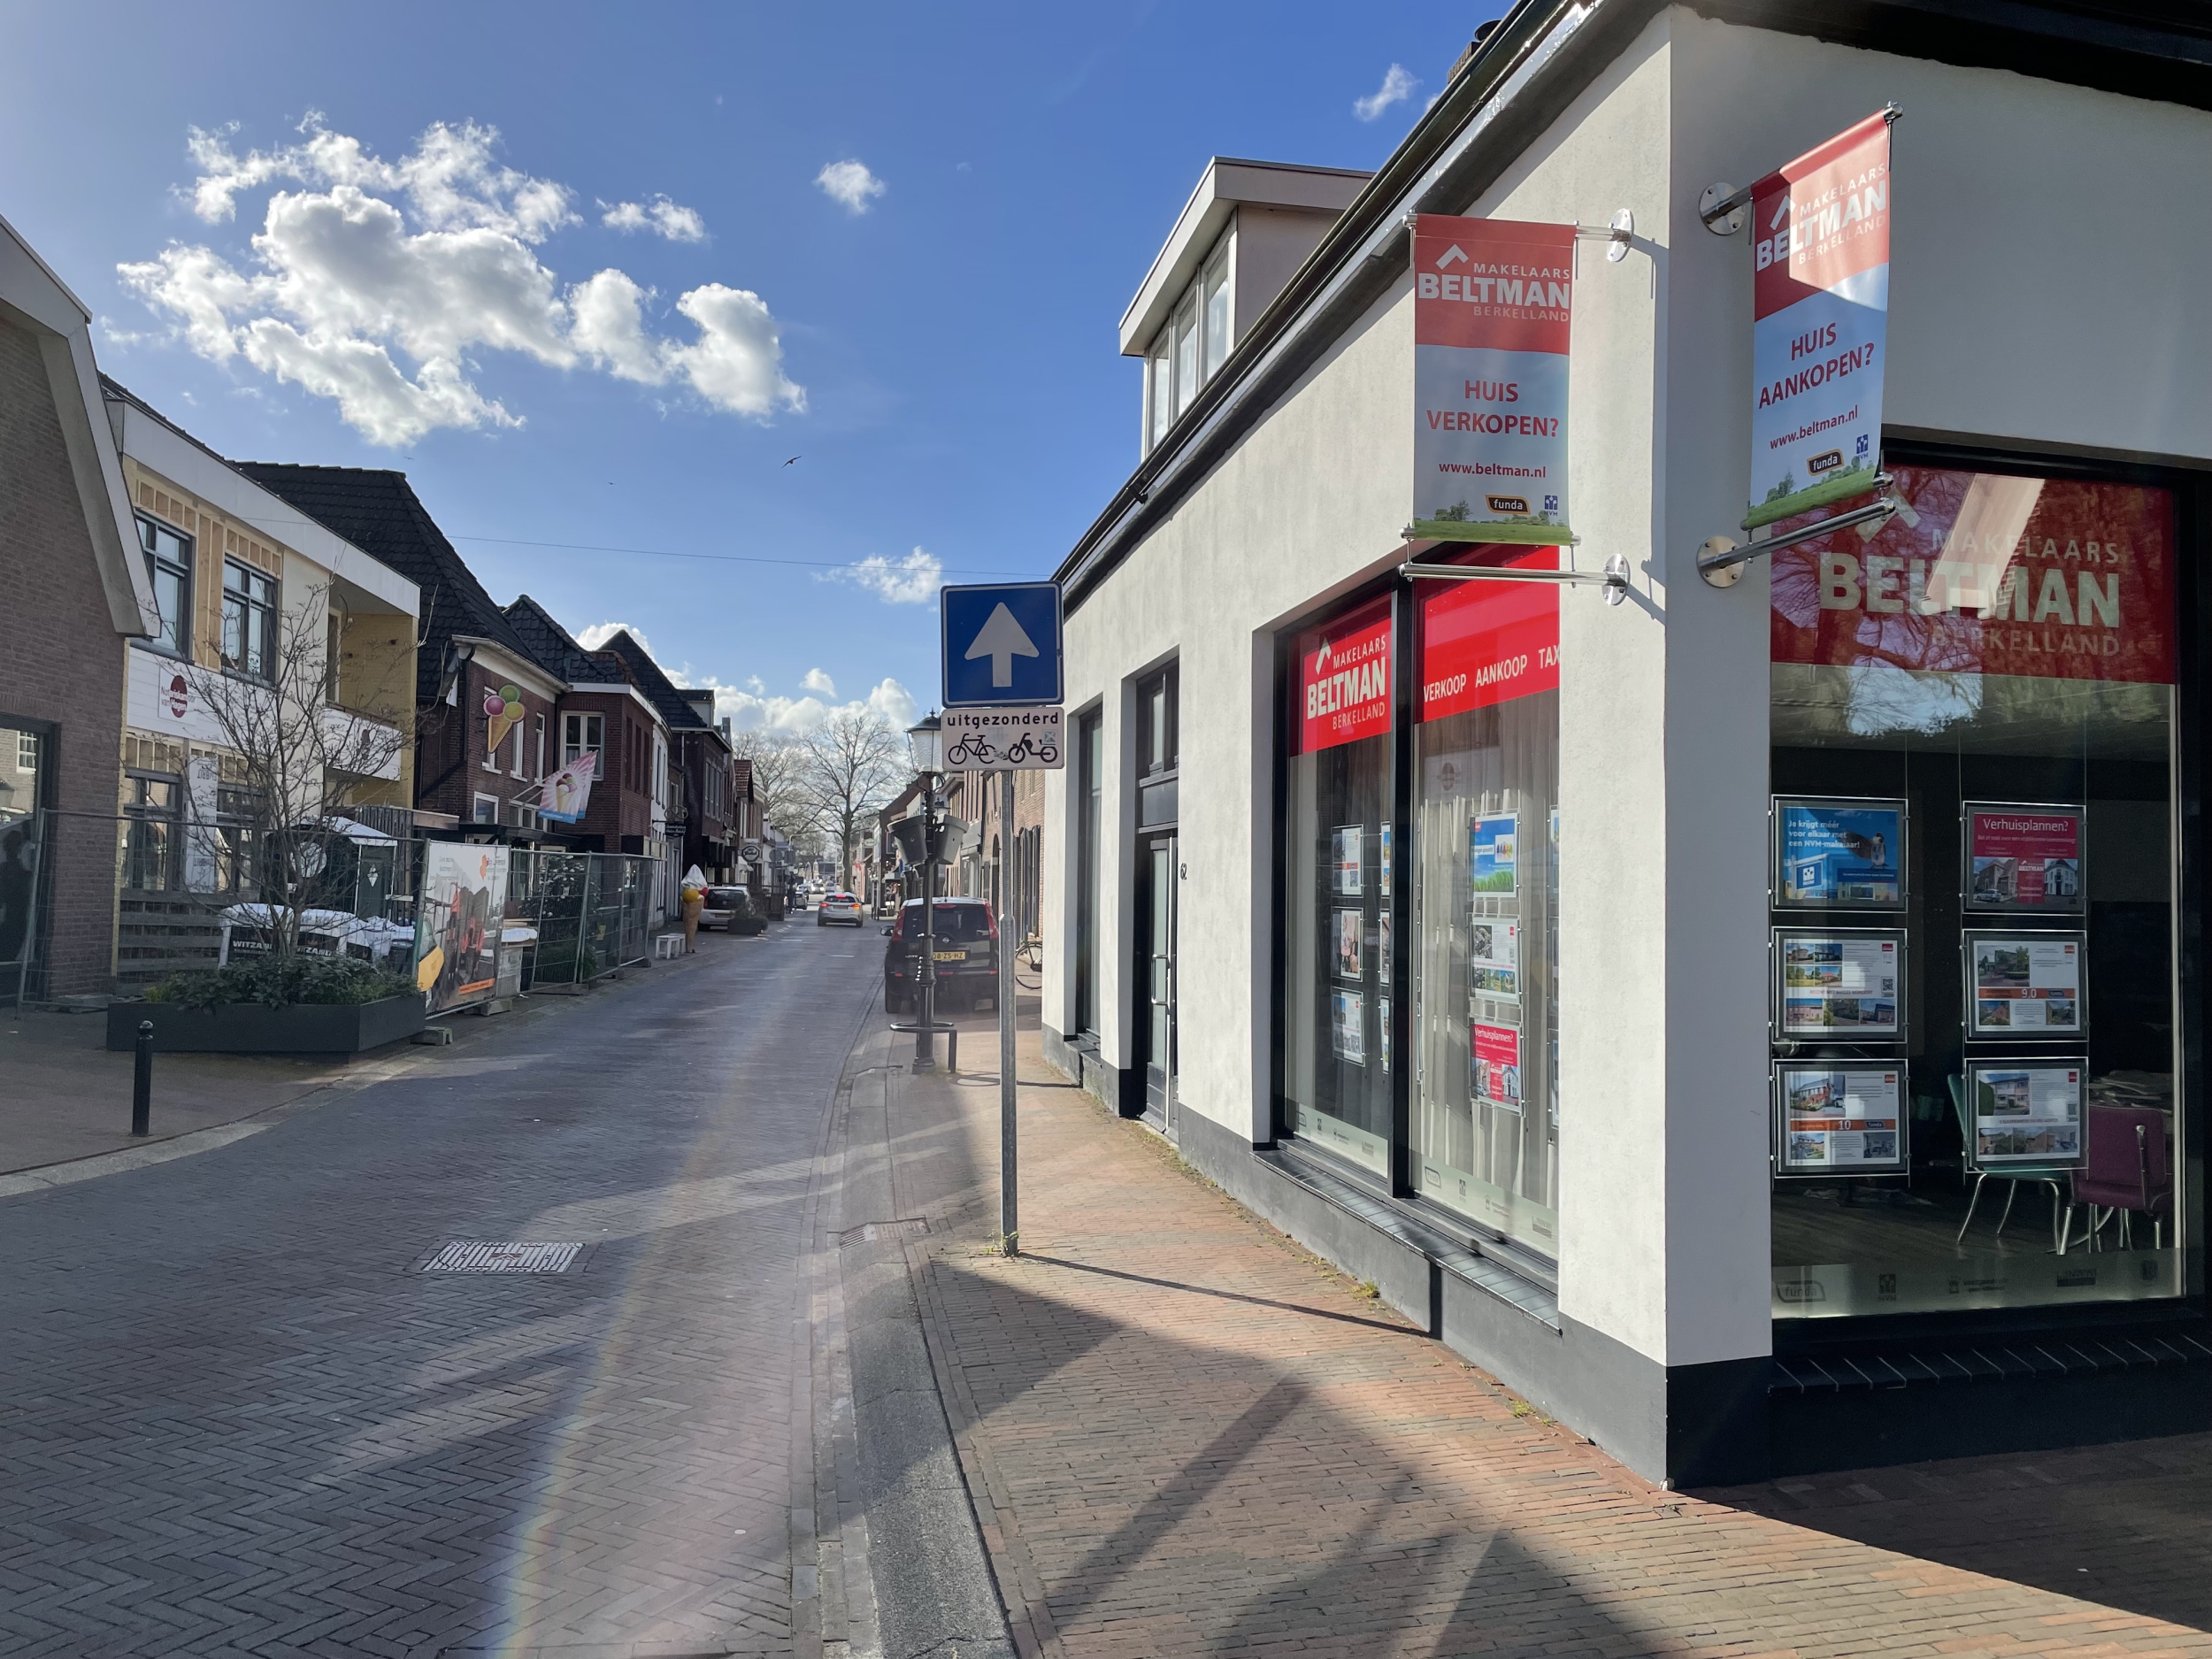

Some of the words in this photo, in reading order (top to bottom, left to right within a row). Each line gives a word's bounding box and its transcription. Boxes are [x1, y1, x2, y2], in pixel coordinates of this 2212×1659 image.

[1800, 162, 1886, 218] MAKELAARS
[1756, 179, 1886, 273] BELTMAN
[1798, 215, 1886, 265] BERKELLAND
[1473, 263, 1571, 280] MAKELAARS
[1417, 273, 1570, 310] BELTMAN
[1473, 305, 1570, 322] BERKELLAND
[1791, 322, 1837, 361] HUIS
[1758, 342, 1875, 410] AANKOPEN?
[1464, 380, 1518, 403] HUIS
[1426, 410, 1559, 438] VERKOPEN?
[1770, 404, 1858, 449] www.beltman.nl
[1439, 463, 1546, 479] www.beltman.nl
[1813, 454, 1839, 471] funda
[1494, 498, 1524, 511] funda
[1932, 527, 2119, 564] MAKELAARS
[1819, 551, 2120, 628] BELTMAN
[1333, 634, 1386, 670] MAKELAARS
[1932, 623, 2120, 657] BERKELLAND
[1307, 656, 1386, 720] BELTMAN
[1424, 673, 1467, 703] VERKOOP
[1475, 655, 1528, 687] AANKOOP
[947, 711, 1059, 730] uitgezonderd
[1333, 702, 1386, 730] BERKELLAND
[1798, 819, 1819, 829] krijgt
[1820, 819, 1839, 828] méér
[1983, 818, 2069, 833] Verhuisplannen?
[1804, 839, 1861, 849] NVM-makelaar!
[1179, 862, 1187, 880] 62
[1474, 1027, 1513, 1042] Verhuisplannen?
[1838, 1120, 1852, 1130] 10
[1785, 1286, 1817, 1297] funda
